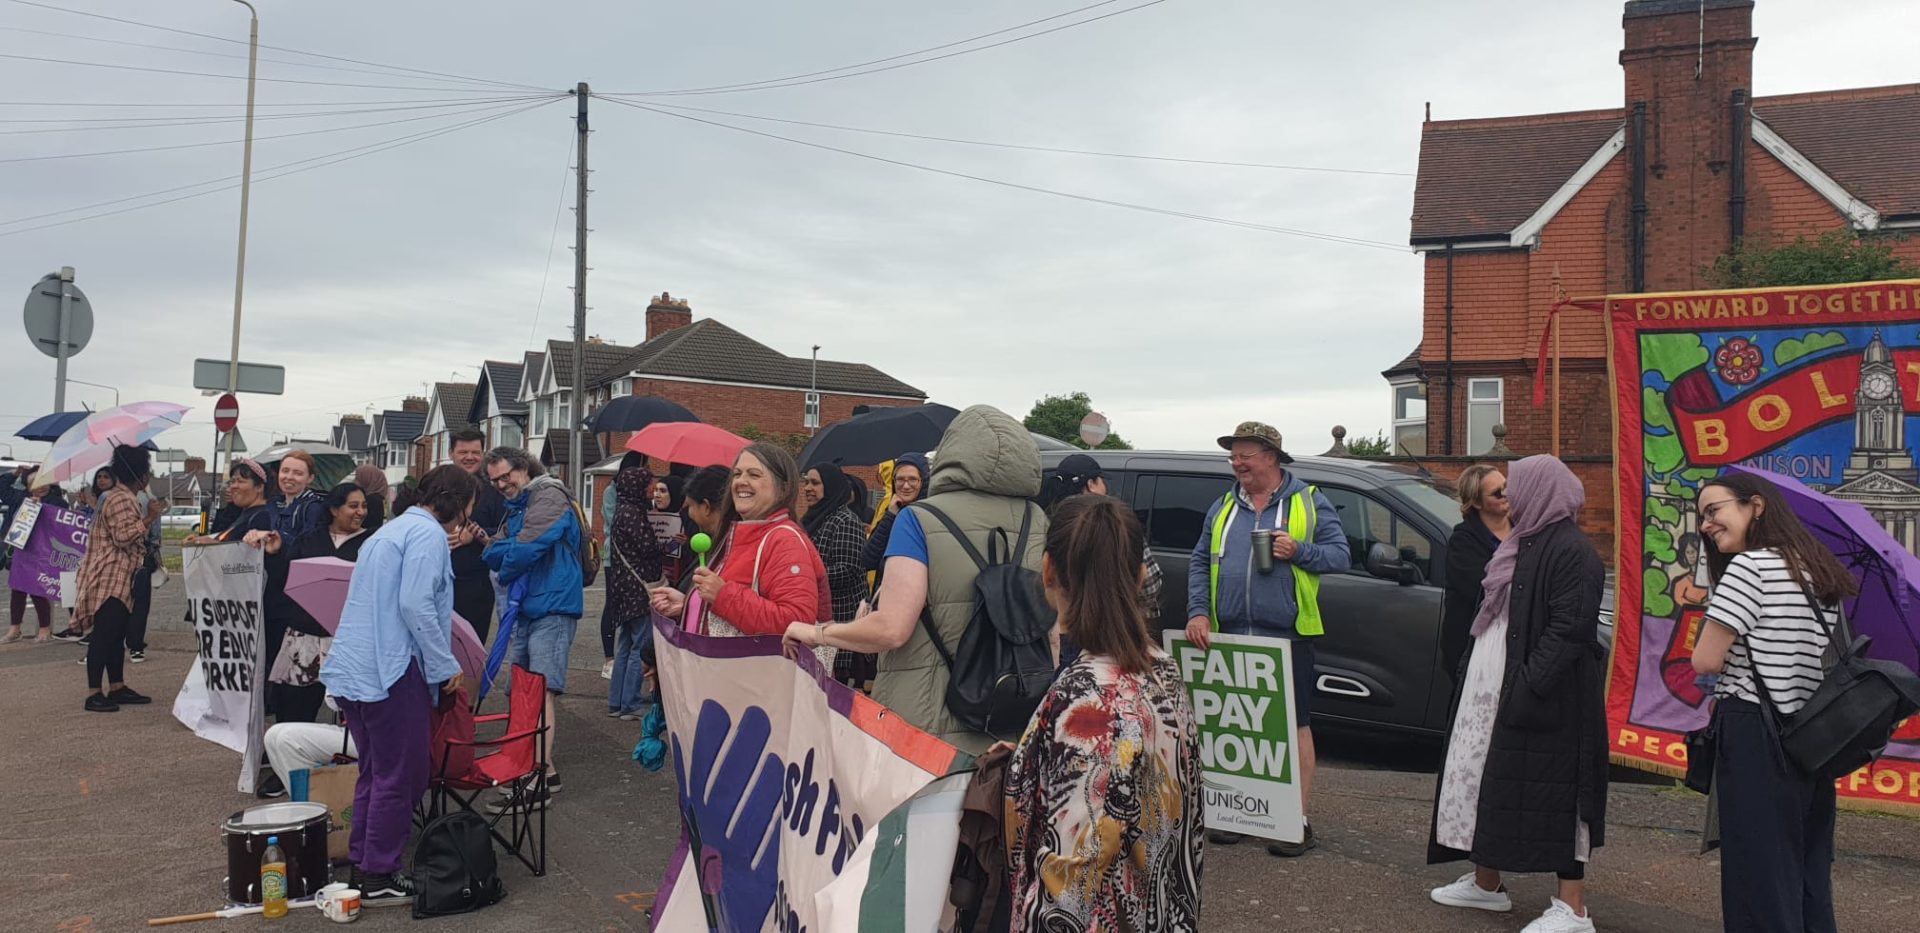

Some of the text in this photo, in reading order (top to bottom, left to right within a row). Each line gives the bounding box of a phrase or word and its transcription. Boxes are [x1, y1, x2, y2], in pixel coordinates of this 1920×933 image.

[1635, 297, 1769, 321] FORWARD
[1739, 453, 1832, 478] NISON
[1180, 646, 1278, 692] FAIR
[1193, 689, 1271, 732] PAY
[1200, 731, 1287, 778] NOW
[1834, 766, 1920, 798] FO
[1206, 790, 1269, 815] UNISON
[1216, 812, 1276, 830] Local Government
